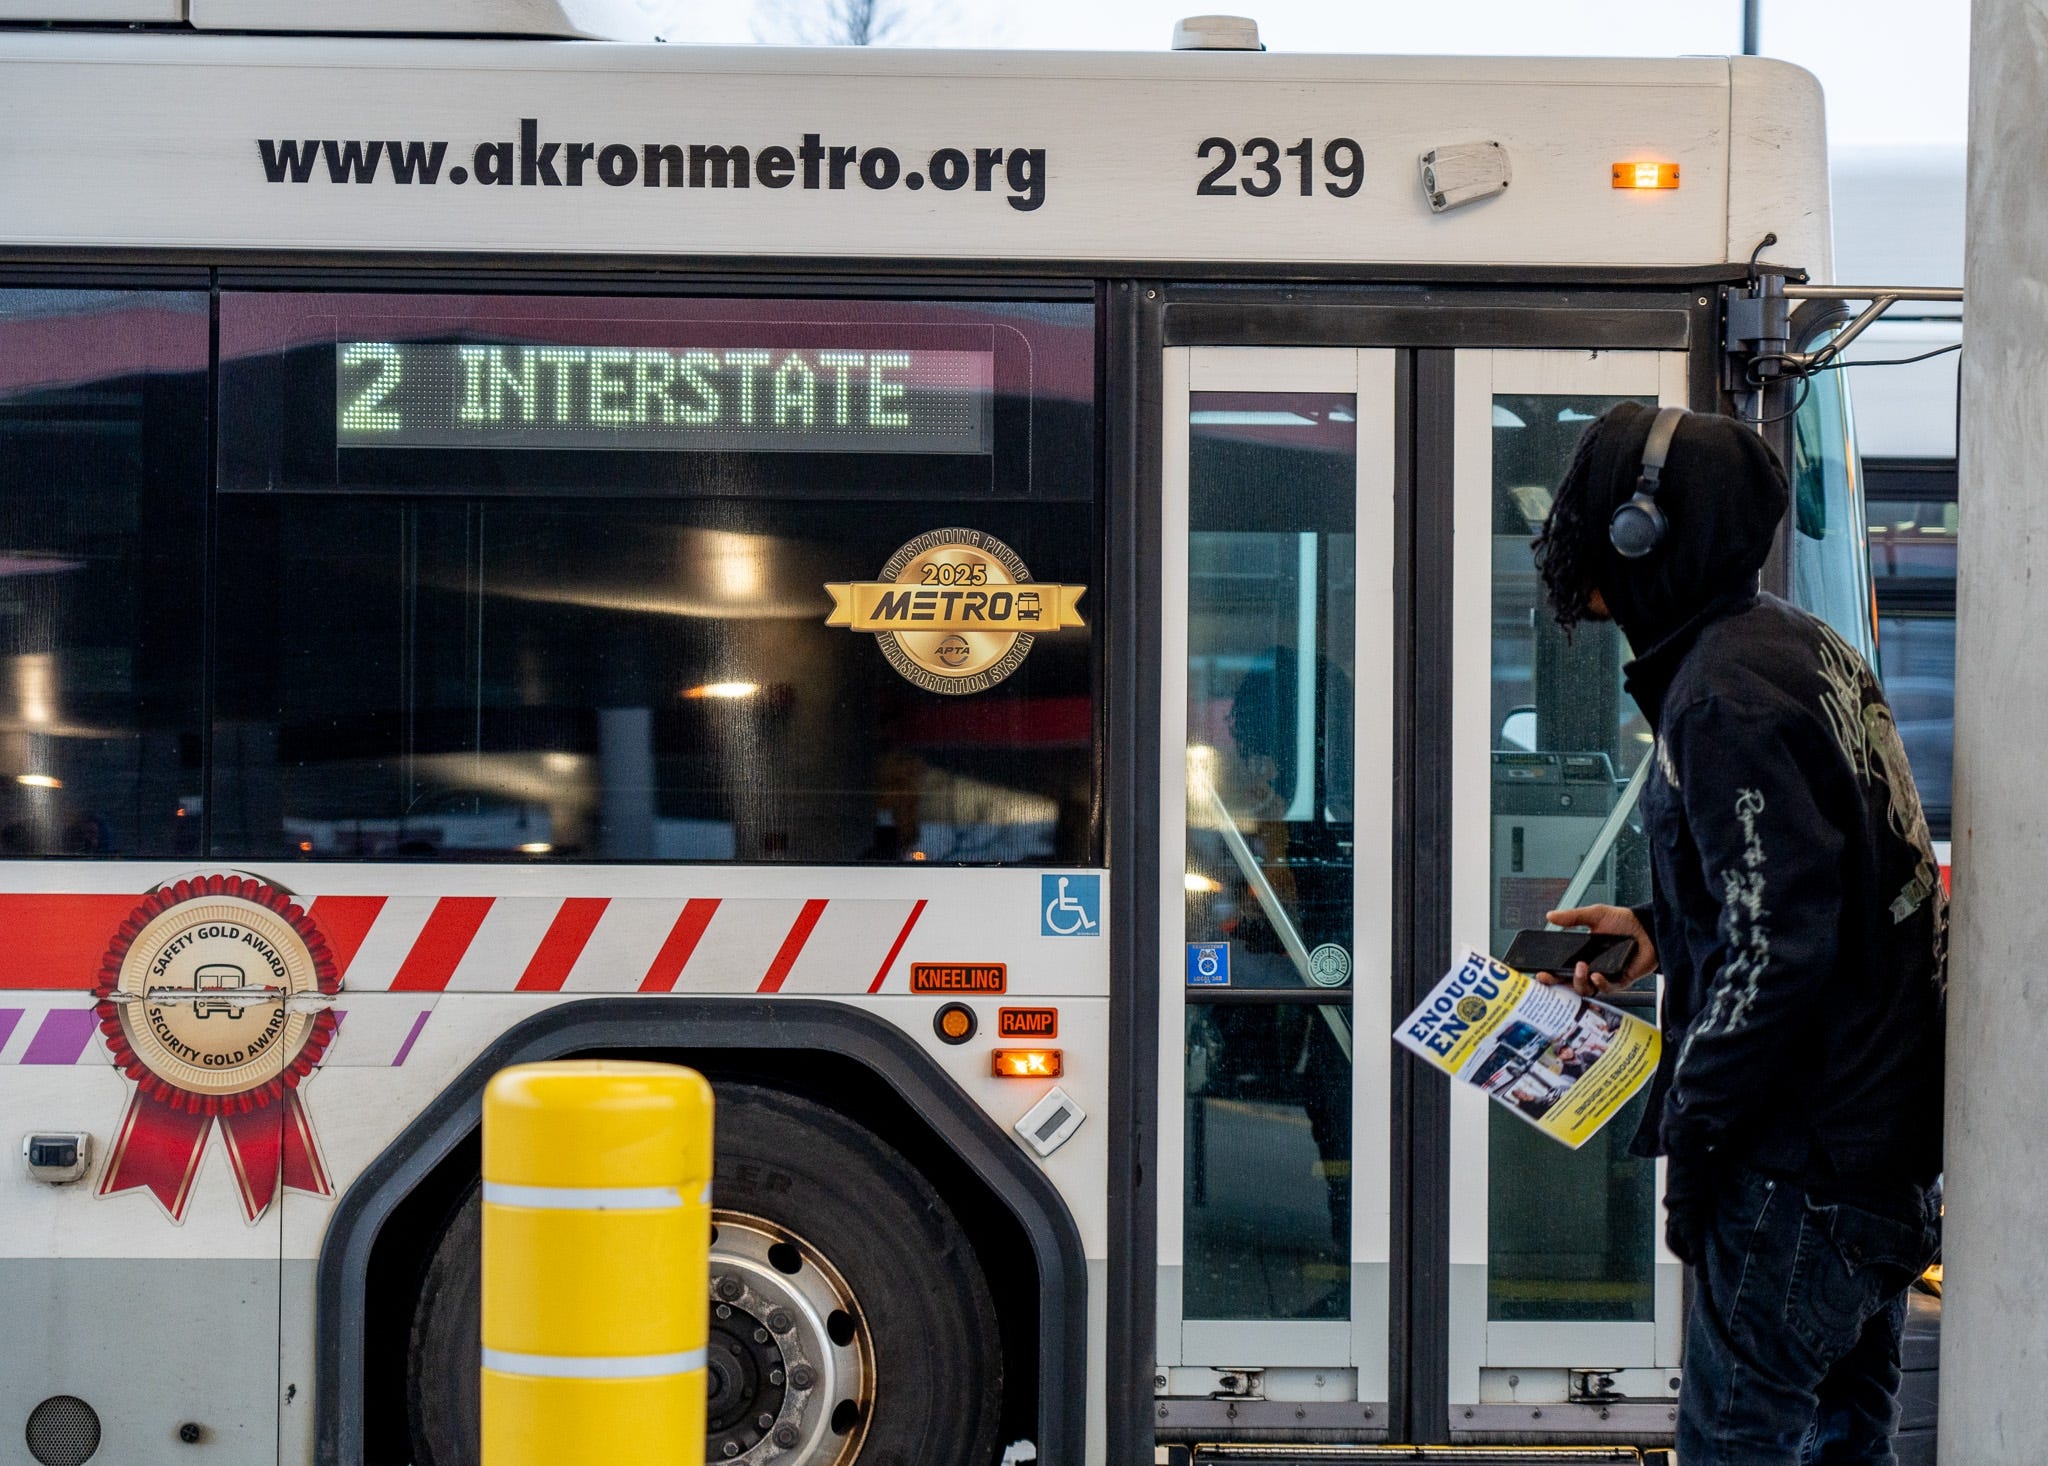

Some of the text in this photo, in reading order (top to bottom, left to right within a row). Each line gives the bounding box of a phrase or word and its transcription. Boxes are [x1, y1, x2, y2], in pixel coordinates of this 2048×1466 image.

[257, 118, 1046, 211] www.akronmetro.org
[1196, 136, 1364, 198] 2319
[342, 342, 911, 431] 2 INTERSTATE
[883, 528, 1029, 582] OUTSTANDING PUBLIC
[920, 563, 987, 586] 2025
[869, 591, 1014, 621] METRO
[878, 632, 1035, 694] TRANSPORTATION SYSTEM
[934, 646, 970, 655] APTA
[153, 926, 286, 978] SAFETY GOLD AWARD
[917, 969, 1000, 989] KNEELING
[1408, 951, 1487, 1042] ENOUGH
[149, 1007, 285, 1066] SECURITY GOLD AWARD
[1003, 1013, 1051, 1031] RAMP
[1611, 1043, 1642, 1081] ENOUGH!
